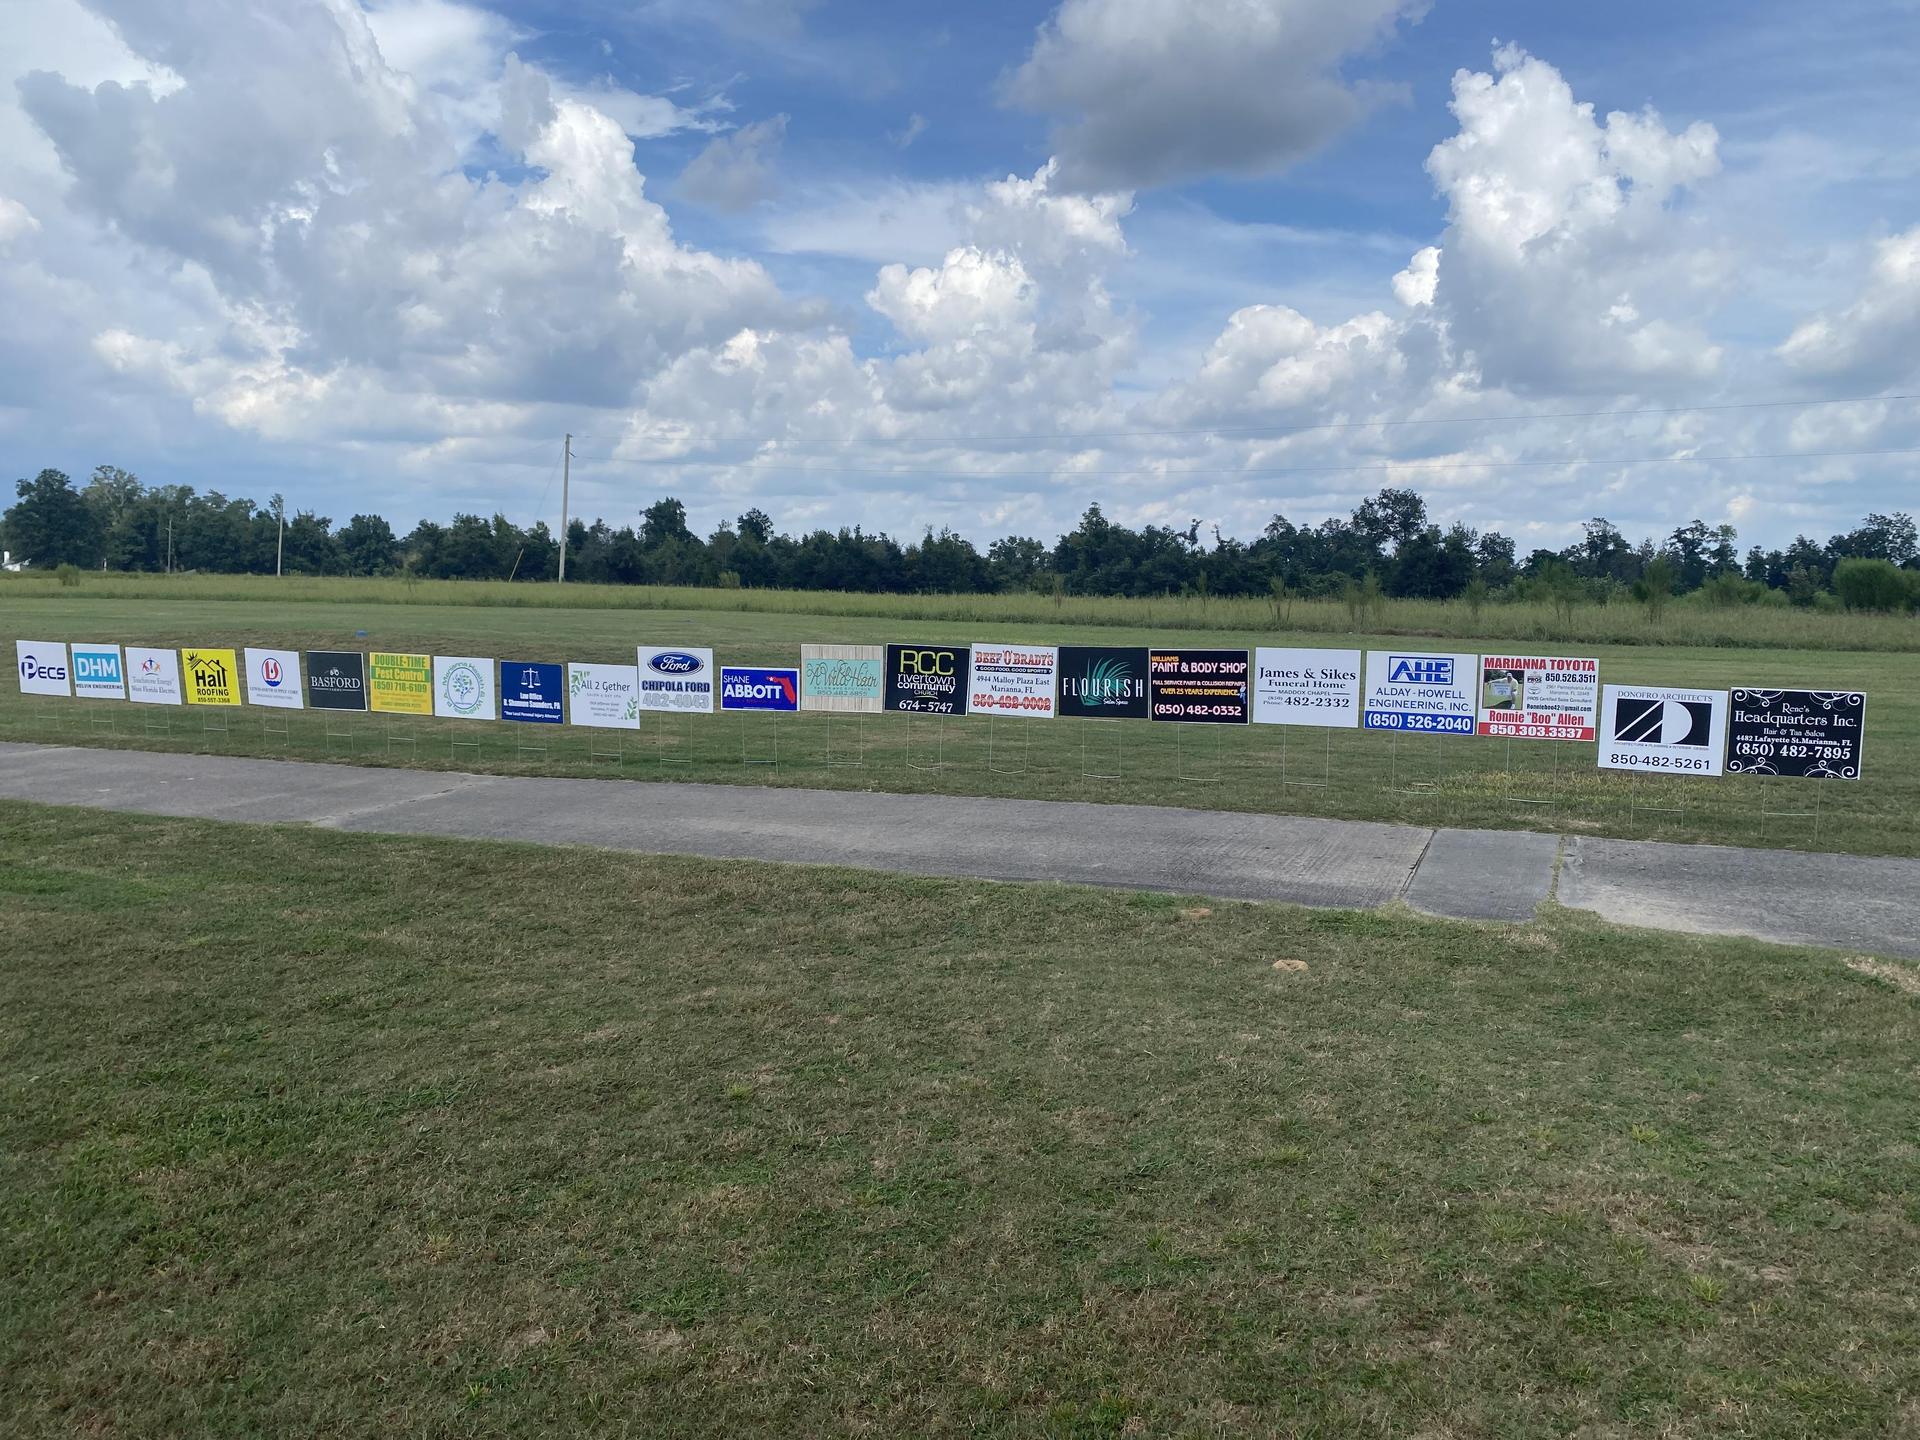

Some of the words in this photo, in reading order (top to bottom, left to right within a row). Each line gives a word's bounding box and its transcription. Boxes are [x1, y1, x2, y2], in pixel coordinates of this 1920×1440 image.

[660, 656, 690, 670] Ford
[900, 650, 954, 675] RCC
[975, 652, 1002, 664] BEEF
[1012, 652, 1054, 666] BRADY'S
[1484, 658, 1546, 670] MARIANNA
[1550, 660, 1595, 671] TOYOTA
[78, 658, 116, 677] DHM
[1152, 662, 1179, 672] PAINT
[1180, 662, 1189, 673] &
[1191, 663, 1218, 673] BODY
[1220, 663, 1246, 673] SHOP
[1260, 667, 1299, 679] James
[1304, 668, 1315, 679] &
[1321, 669, 1356, 680] Sikes
[1391, 660, 1451, 682] AHE
[195, 668, 226, 688] Hall
[376, 668, 393, 679] Pest
[395, 668, 425, 681] Control
[724, 675, 750, 684] SHANE
[898, 673, 956, 685] rivertown
[992, 676, 1014, 685] Malloy
[311, 676, 360, 688] BASFORD
[581, 680, 592, 690] All
[596, 682, 600, 690] 2
[602, 682, 630, 692] Gether
[642, 680, 684, 692] CHIPOLA
[685, 682, 710, 692] FORD
[897, 682, 956, 693] community
[1064, 678, 1143, 698] FLOURISH
[197, 688, 229, 696] ROOFING
[724, 684, 782, 699] ABBOTT
[990, 685, 1023, 693] Marianna,
[1376, 688, 1411, 696] ALDAY
[1418, 690, 1466, 699] HOWELL
[1618, 690, 1658, 700] DONOFRO
[1660, 693, 1713, 701] ARCHITECTS
[899, 700, 953, 712] 674-5747
[1284, 696, 1350, 708] 482-2332
[1369, 699, 1447, 711] ENGINEERING,
[1450, 703, 1471, 712] INC.
[1154, 704, 1184, 715] (850)
[1186, 705, 1241, 716] 482-0332
[1368, 713, 1402, 728] (850)
[1407, 716, 1471, 730] 526-2040
[1490, 710, 1524, 723] Ronnie
[1527, 712, 1556, 725] "Boo"
[1558, 714, 1584, 726] Allen
[1734, 710, 1828, 727] Headquarters
[1833, 714, 1857, 727] Inc.
[1490, 724, 1582, 738] 850.303.3337
[1755, 735, 1790, 745] Lafayette
[1736, 743, 1774, 757] (850)
[1780, 745, 1851, 759] 482-7895
[1610, 754, 1710, 770] 850-482-5261
